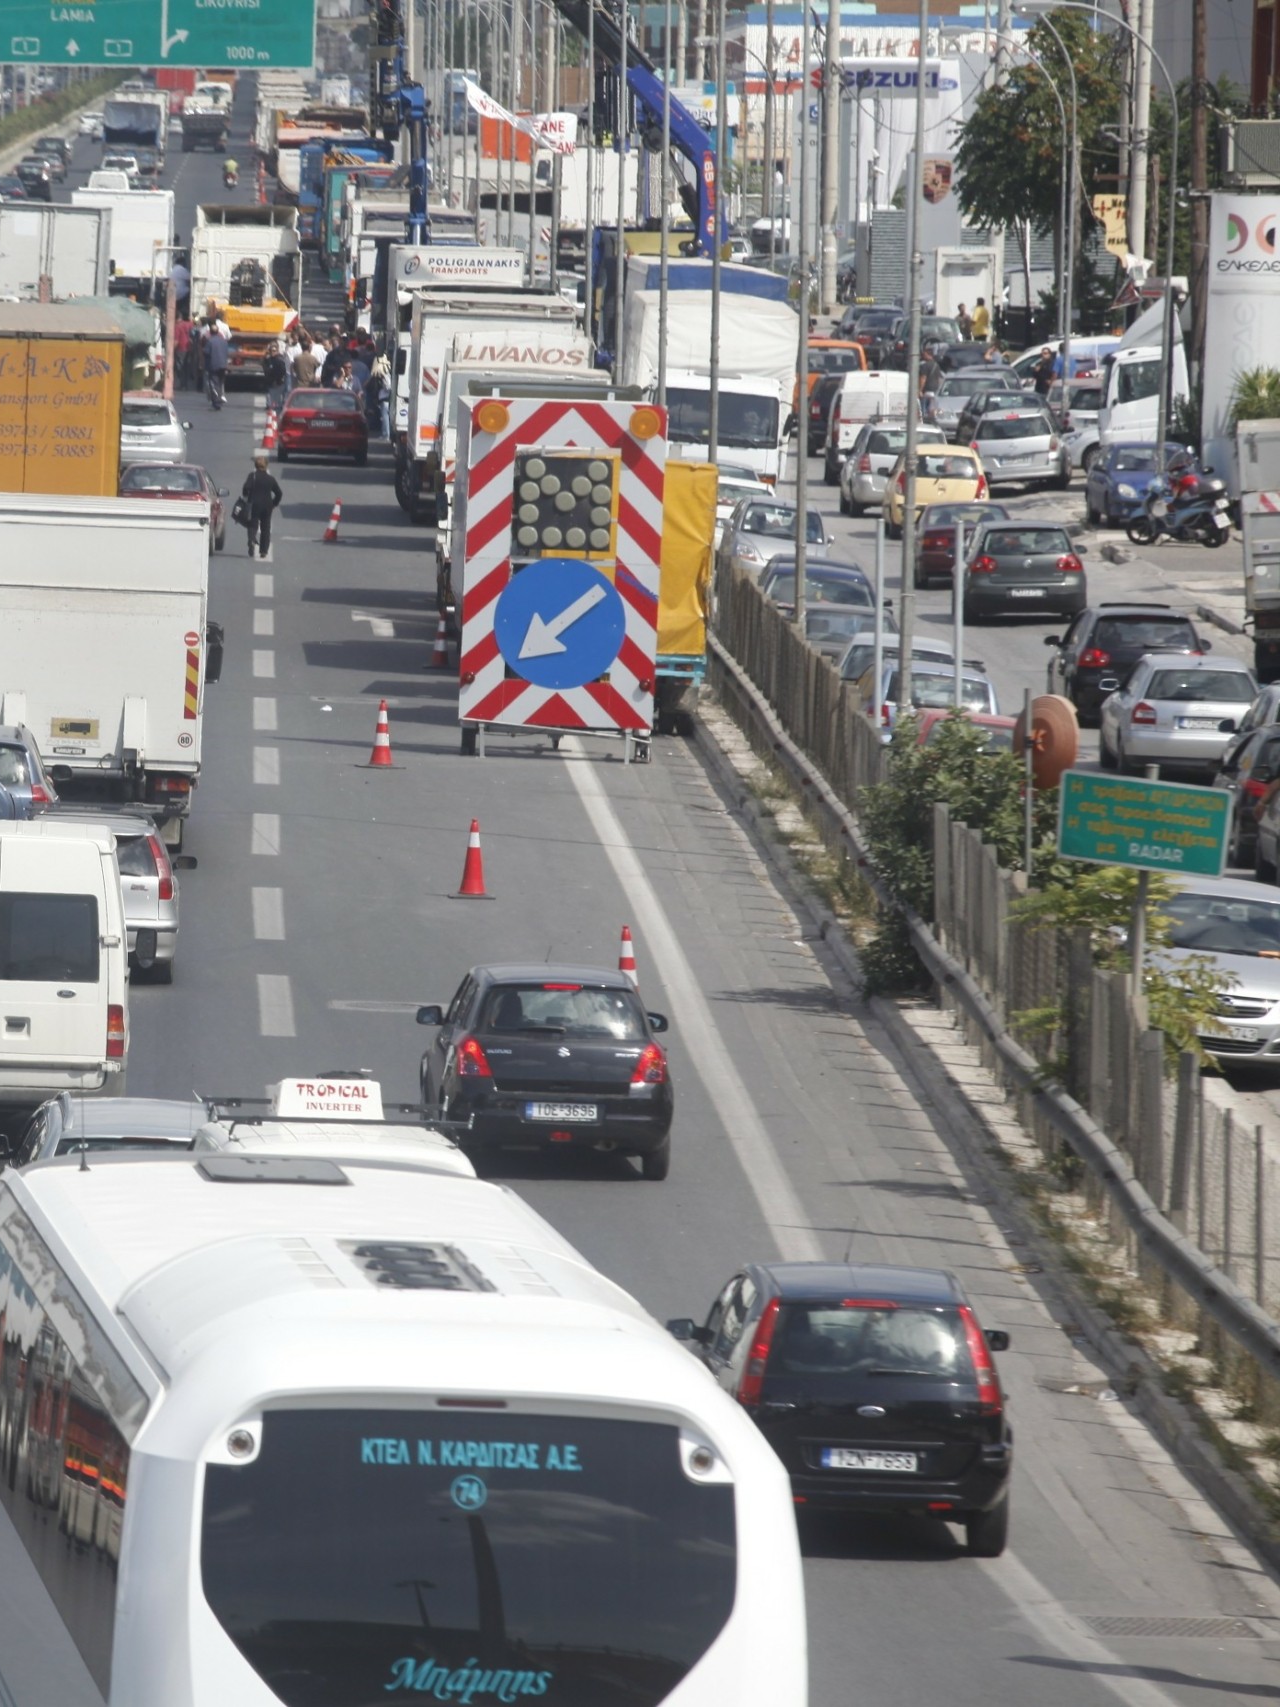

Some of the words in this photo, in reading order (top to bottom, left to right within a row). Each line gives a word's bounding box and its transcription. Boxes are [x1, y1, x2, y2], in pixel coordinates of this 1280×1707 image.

[226, 46, 254, 60] 1000
[428, 257, 521, 268] POLIGIANNAKIS
[430, 266, 489, 275] TRANSPORTS
[462, 345, 585, 366] LIVANOS
[52, 391, 100, 409] GmbH
[1129, 843, 1184, 863] RADAR
[296, 1083, 369, 1099] TROPICAL
[306, 1101, 362, 1112] INVERTER
[361, 1438, 410, 1465] ΚΤΕΛ
[440, 1440, 540, 1470] ΚΑΡΔΙΤΣΑΣ
[546, 1444, 583, 1471] Α.Ε.
[458, 1481, 481, 1503] 74
[384, 1656, 553, 1705] Μπάμπης
